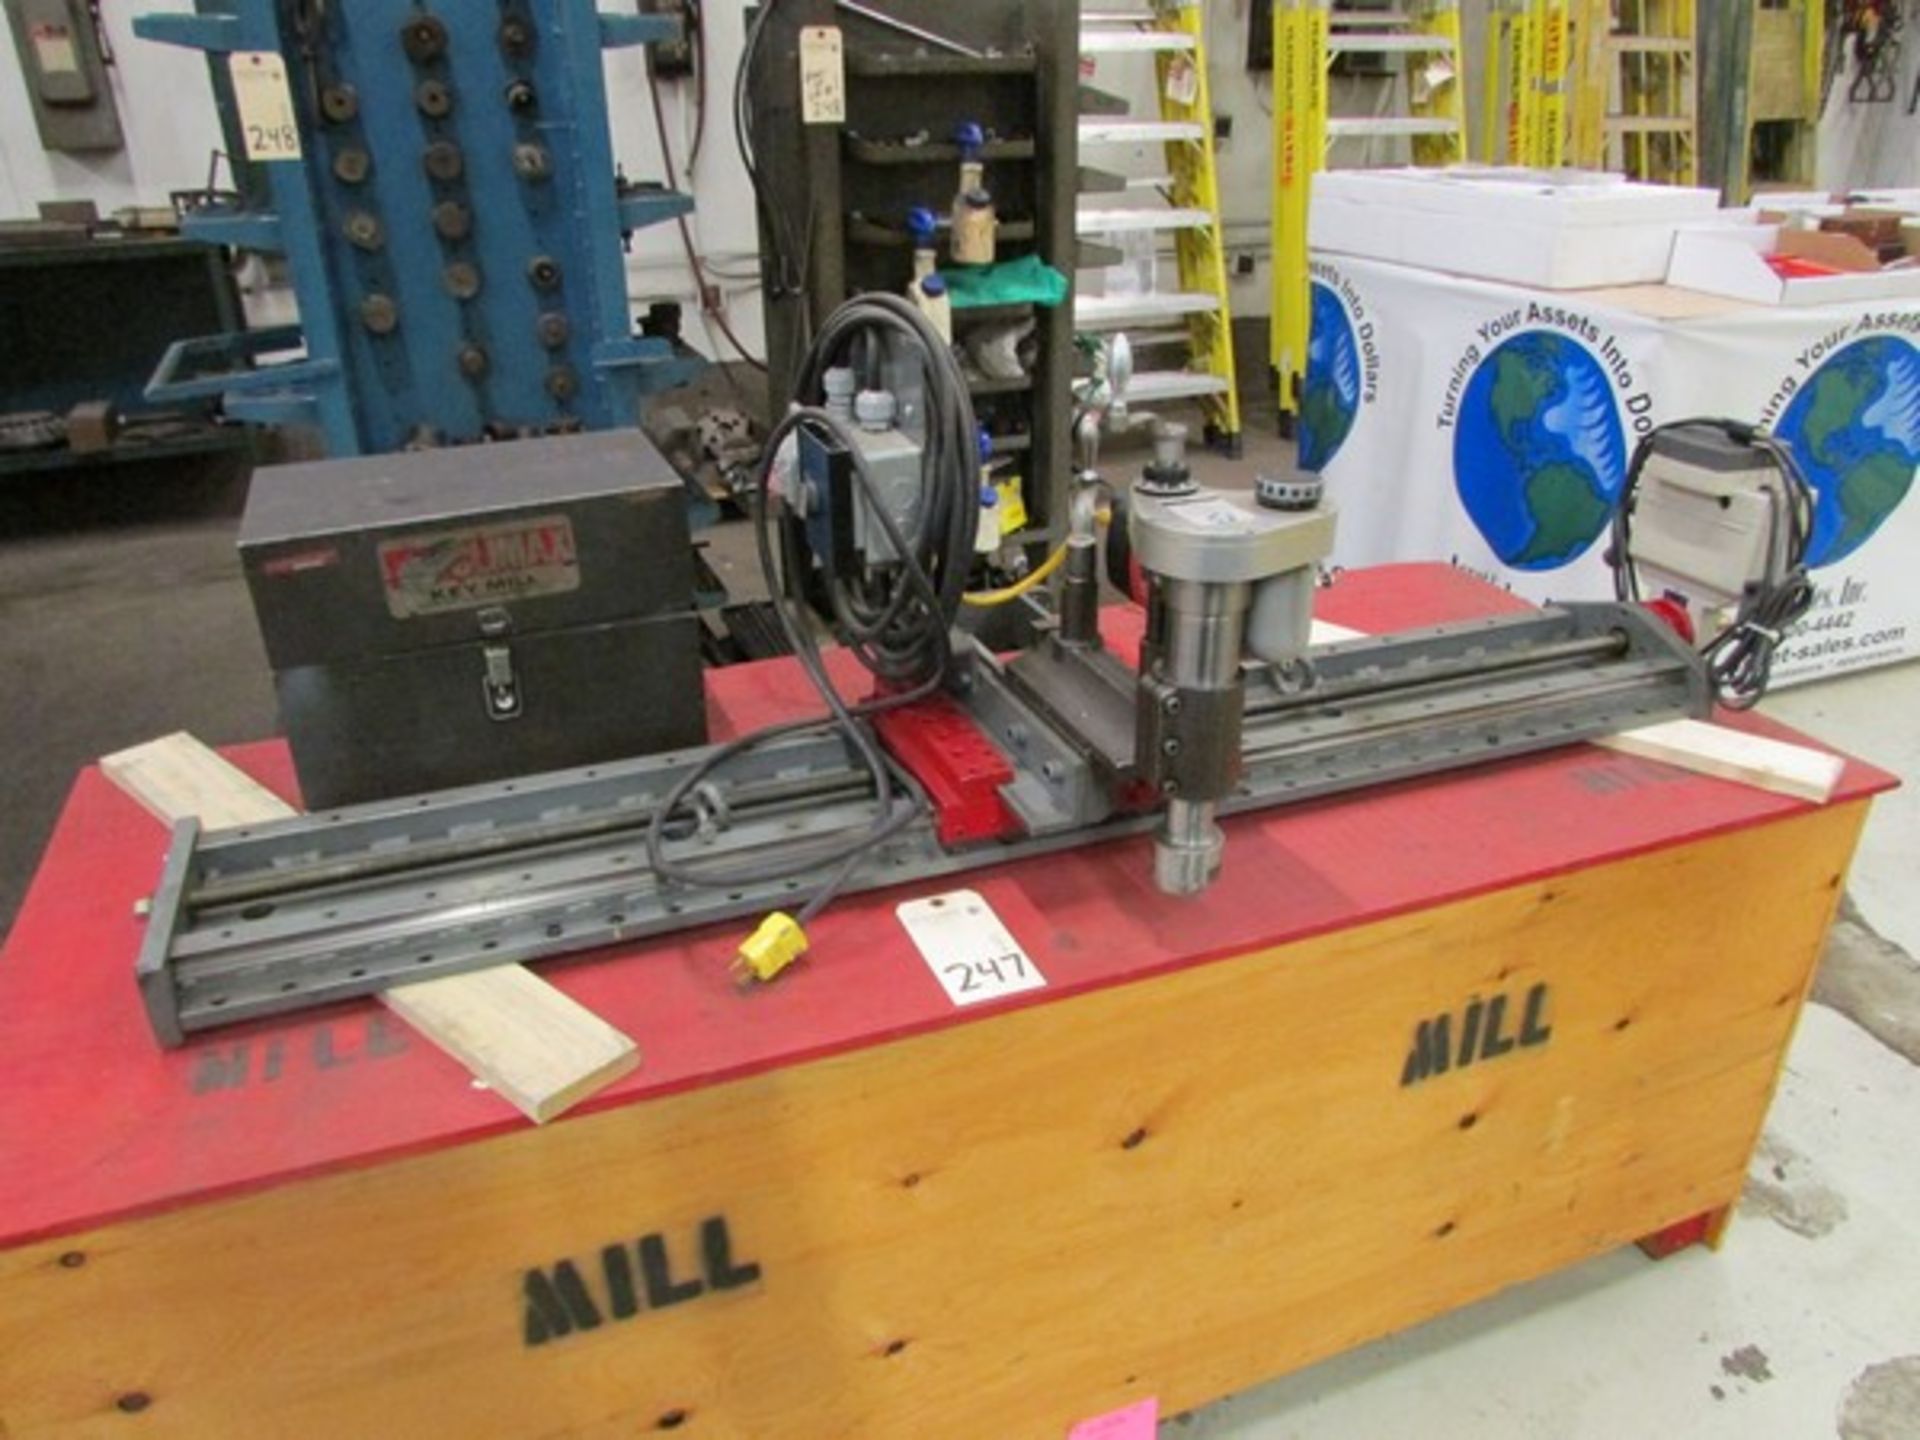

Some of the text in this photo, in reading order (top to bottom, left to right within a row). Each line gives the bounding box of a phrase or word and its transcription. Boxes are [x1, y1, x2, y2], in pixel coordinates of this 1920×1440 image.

[248, 123, 296, 152] 248
[1359, 323, 1379, 404] Dollars
[1436, 344, 1481, 430] Turning
[1476, 309, 1521, 343] Your
[1526, 302, 1600, 343] Assets
[1599, 336, 1633, 390] Into
[1796, 324, 1851, 369] Your
[943, 952, 1026, 993] 247
[191, 1016, 412, 1096] MILL
[1400, 982, 1552, 1087] MILL
[524, 1213, 762, 1346] MILL
